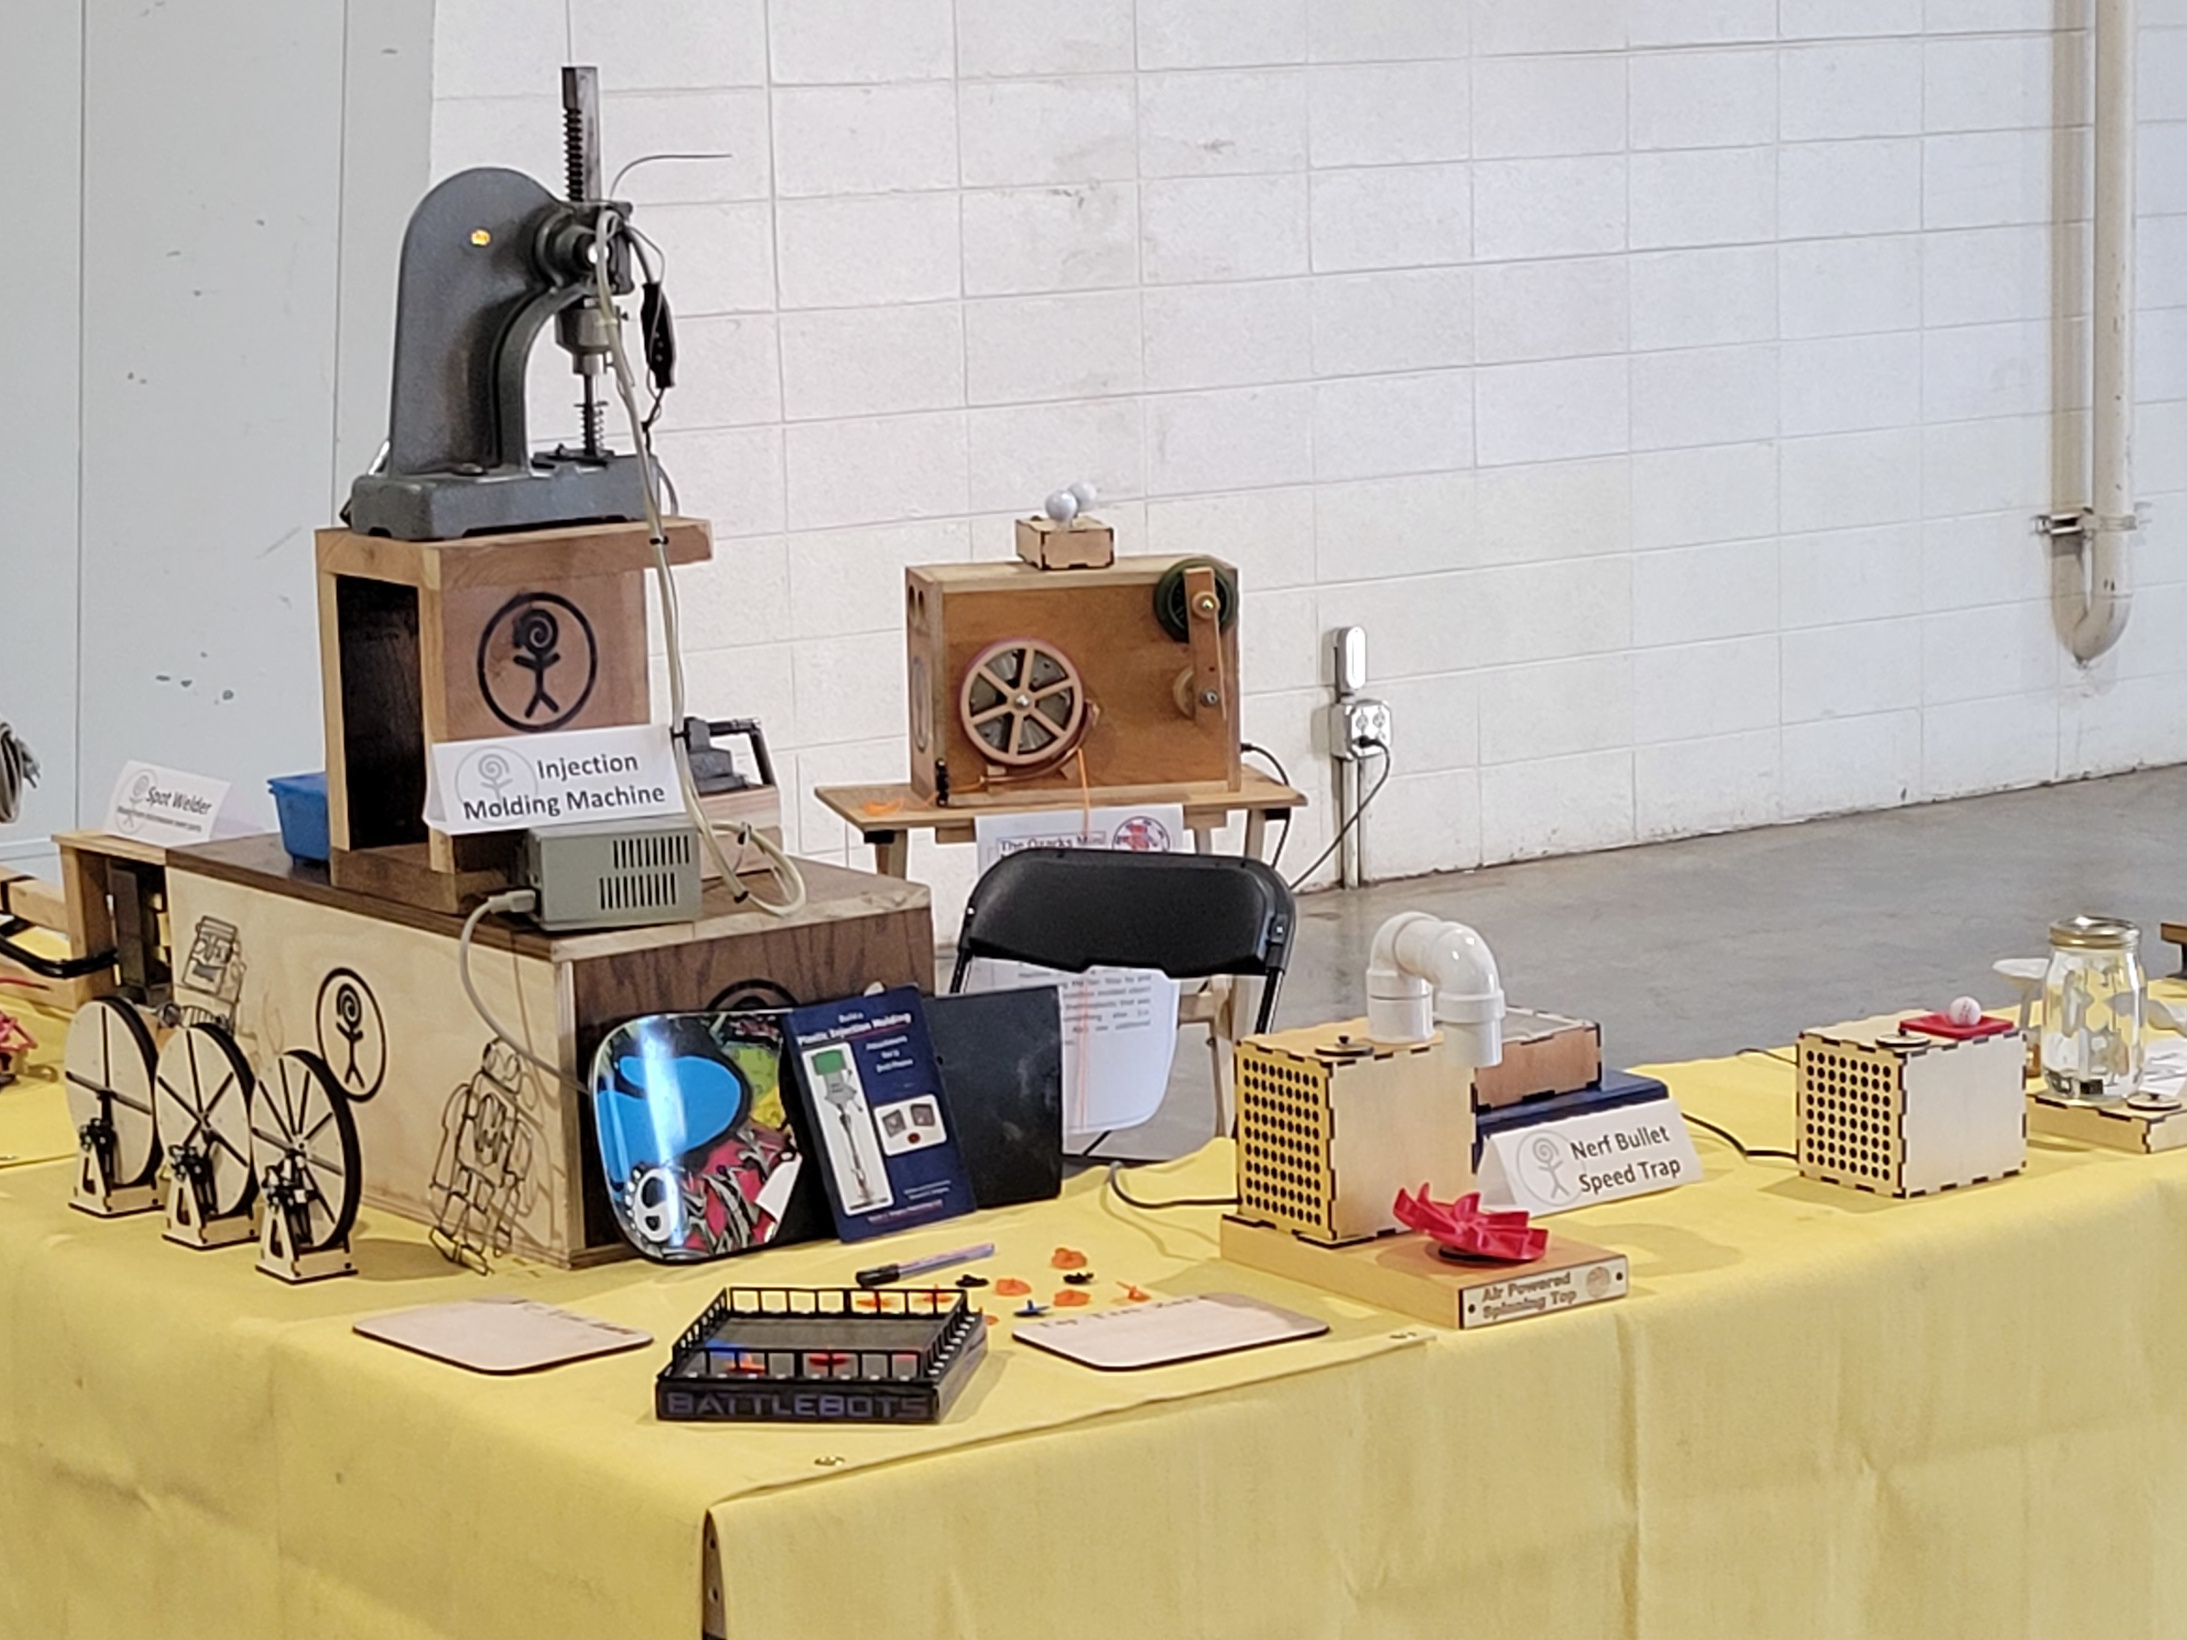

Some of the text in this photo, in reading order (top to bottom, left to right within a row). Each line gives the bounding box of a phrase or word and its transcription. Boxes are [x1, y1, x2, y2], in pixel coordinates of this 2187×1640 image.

[537, 754, 638, 782] Injection
[146, 786, 212, 815] Spot Welder
[463, 785, 665, 821] Molding Machine
[1570, 1125, 1671, 1160] Nerf Bullet
[1578, 1159, 1681, 1195] Speed Trap
[1482, 1271, 1571, 1303] Air Powered
[1483, 1290, 1577, 1320] Spinning Top
[667, 1391, 929, 1419] BATTLEBOTS
